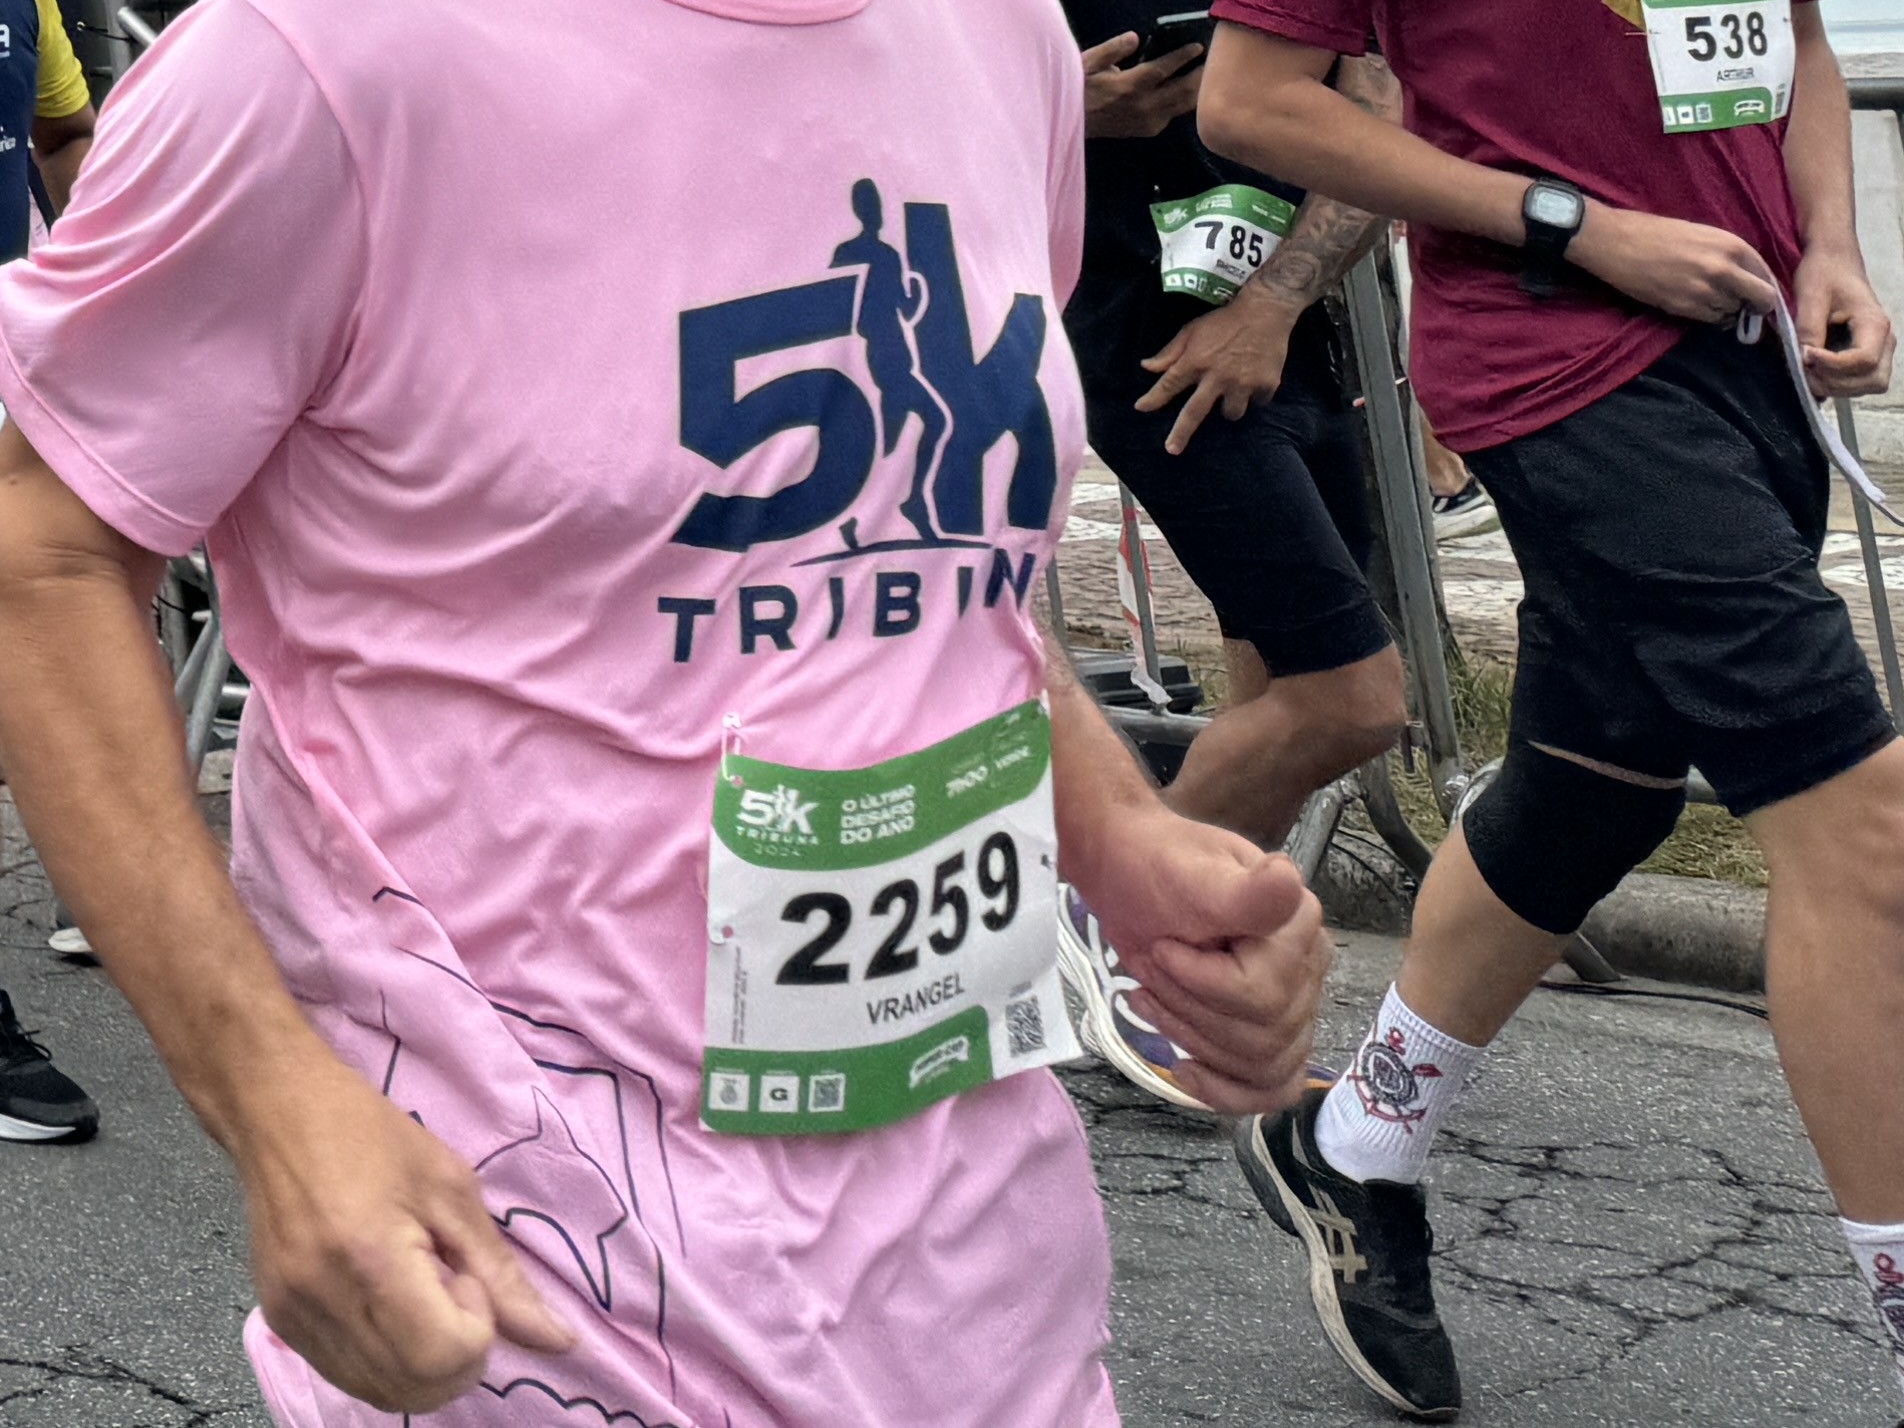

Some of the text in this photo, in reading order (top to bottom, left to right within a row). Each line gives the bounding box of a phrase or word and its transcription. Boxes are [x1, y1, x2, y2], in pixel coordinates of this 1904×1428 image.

[1685, 11, 1768, 62] 538
[1194, 221, 1264, 268] 785
[840, 815, 915, 845] DO ANO
[775, 831, 1019, 986] 2259
[866, 973, 966, 1025] VRANGEL
